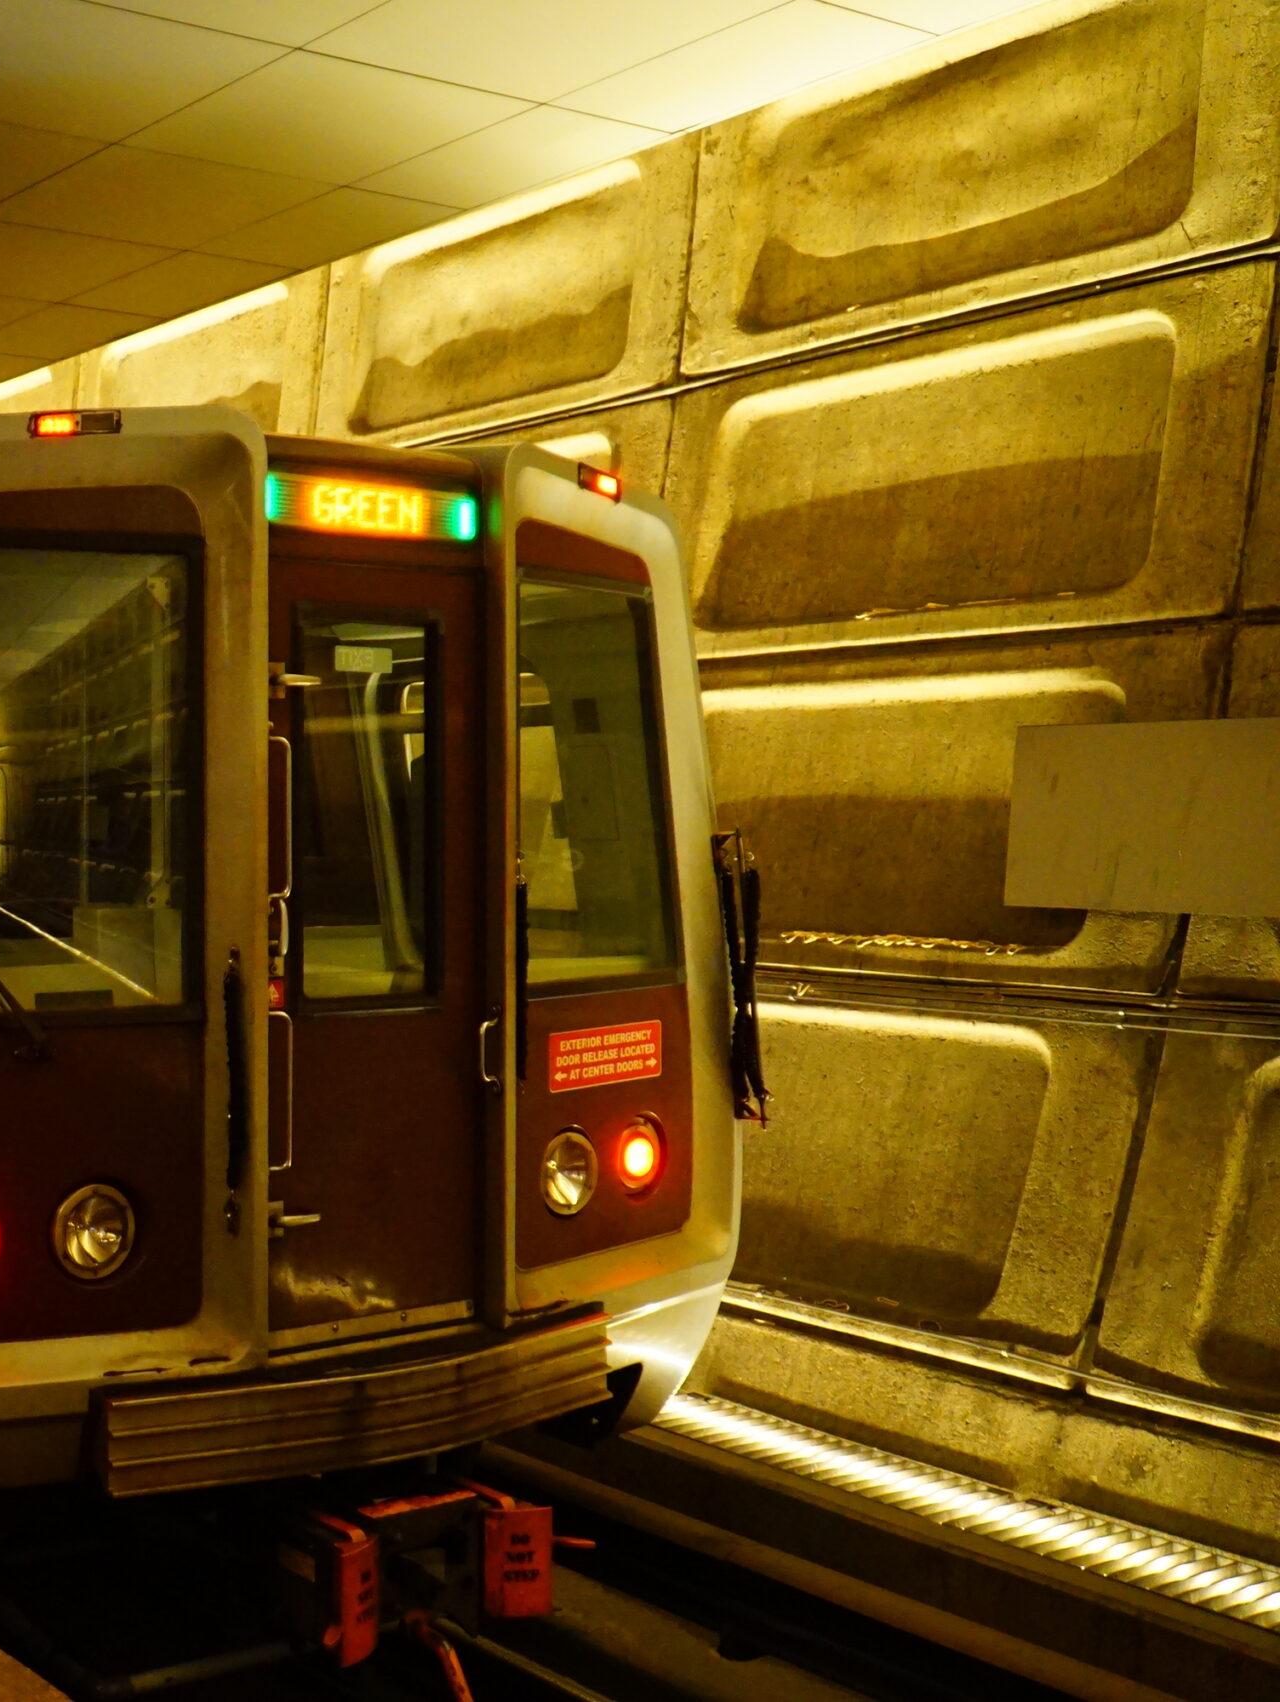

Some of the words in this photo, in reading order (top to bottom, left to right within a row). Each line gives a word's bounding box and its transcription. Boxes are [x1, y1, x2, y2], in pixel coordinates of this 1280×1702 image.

[312, 485, 424, 535] GREEN
[560, 1036, 602, 1051] EXTERIOR
[604, 1029, 652, 1045] EMERGENCY
[556, 1054, 581, 1067] DOOR
[582, 1048, 618, 1064] RELEASE
[620, 1043, 656, 1058] LOCATED
[569, 1070, 580, 1081] AT
[582, 1065, 615, 1079] CENTER
[617, 1059, 644, 1072] DOORS
[505, 1550, 535, 1563] NOT
[502, 1568, 539, 1583] STEP
